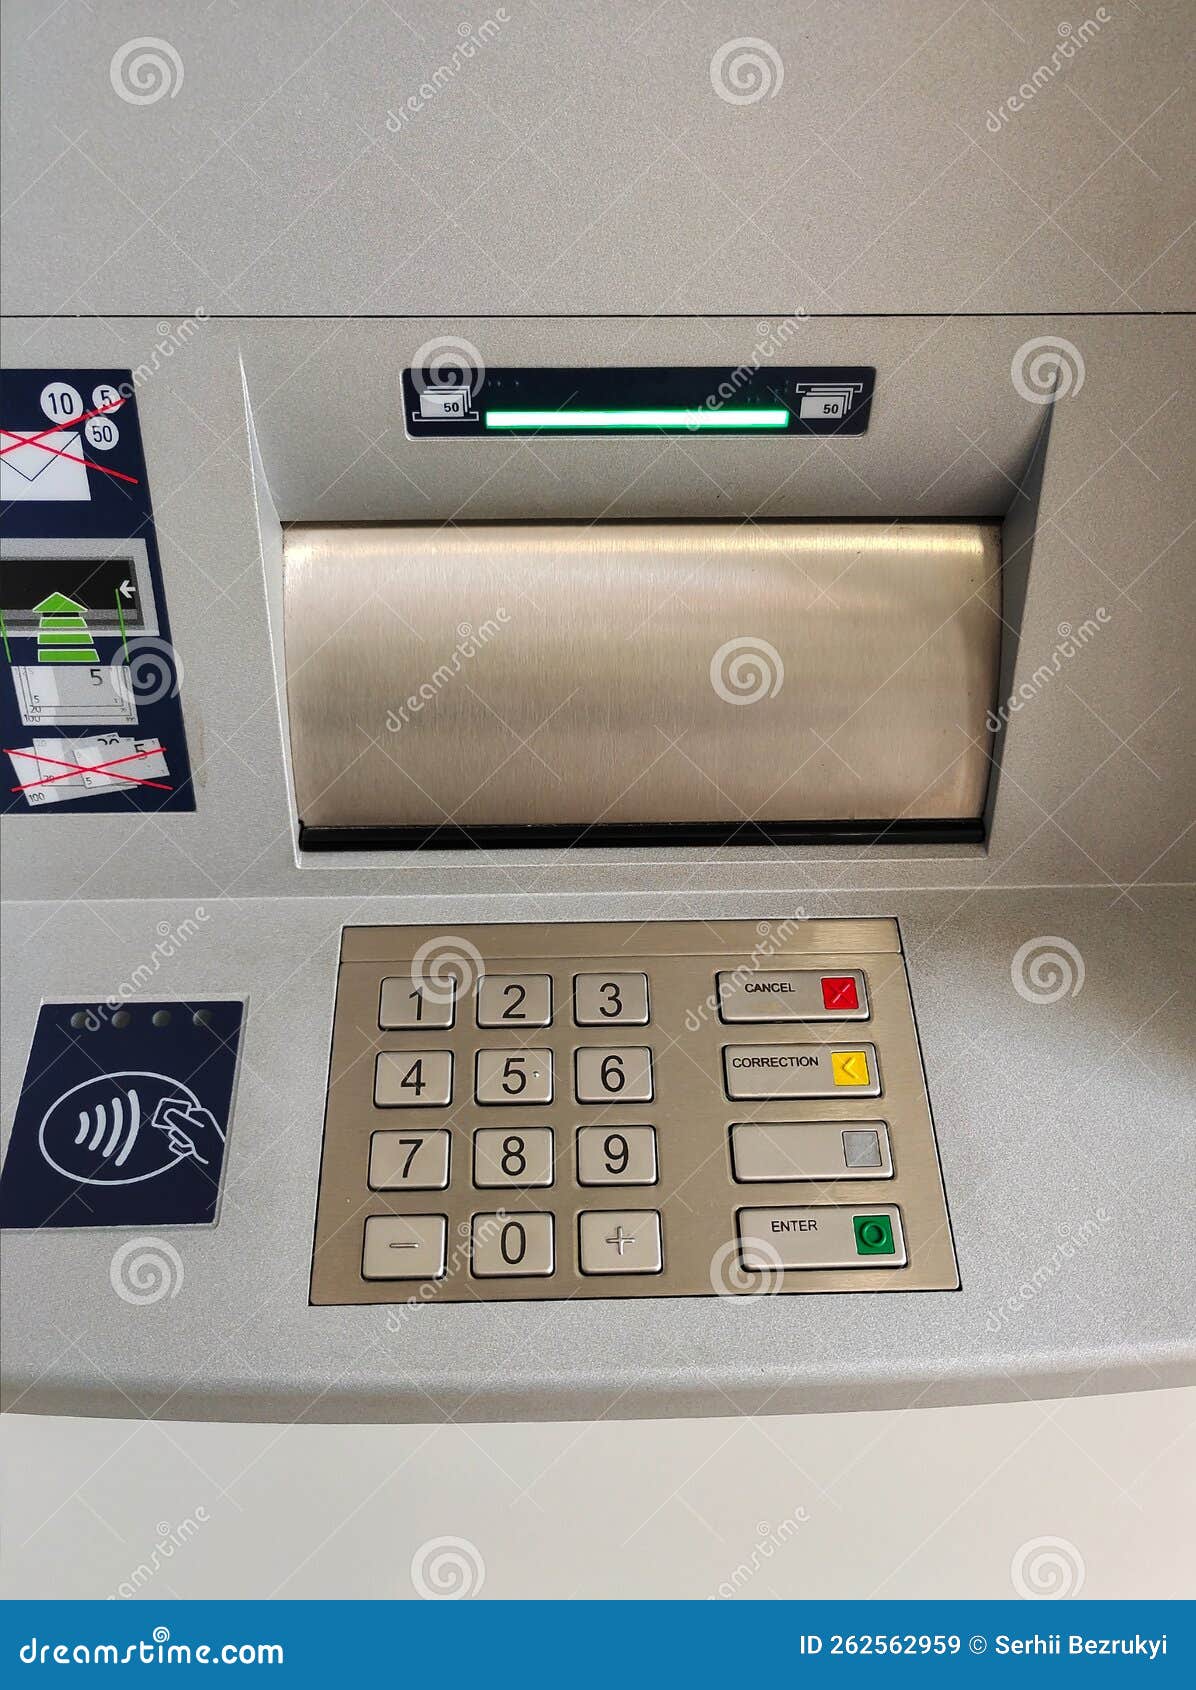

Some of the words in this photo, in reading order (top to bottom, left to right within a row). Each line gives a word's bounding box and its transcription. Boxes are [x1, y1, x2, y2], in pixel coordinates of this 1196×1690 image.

[48, 392, 74, 415] 10
[100, 389, 113, 407] 5
[444, 402, 460, 413] 50
[823, 403, 839, 414] 50
[92, 425, 113, 443] 50
[90, 668, 103, 686] 5
[85, 776, 92, 785] 5
[28, 792, 45, 802] 100
[744, 982, 796, 993] CANCEL
[408, 986, 423, 1021] 1
[502, 984, 527, 1019] 2
[599, 982, 623, 1017] 3
[732, 1056, 819, 1068] CORRECTION
[400, 1059, 426, 1096] 4
[502, 1057, 527, 1095] 5
[600, 1055, 625, 1093] 6
[398, 1138, 423, 1178] 7
[501, 1135, 526, 1176] 8
[603, 1133, 629, 1174] 9
[771, 1219, 818, 1232] ENTER
[500, 1221, 526, 1265] 0
